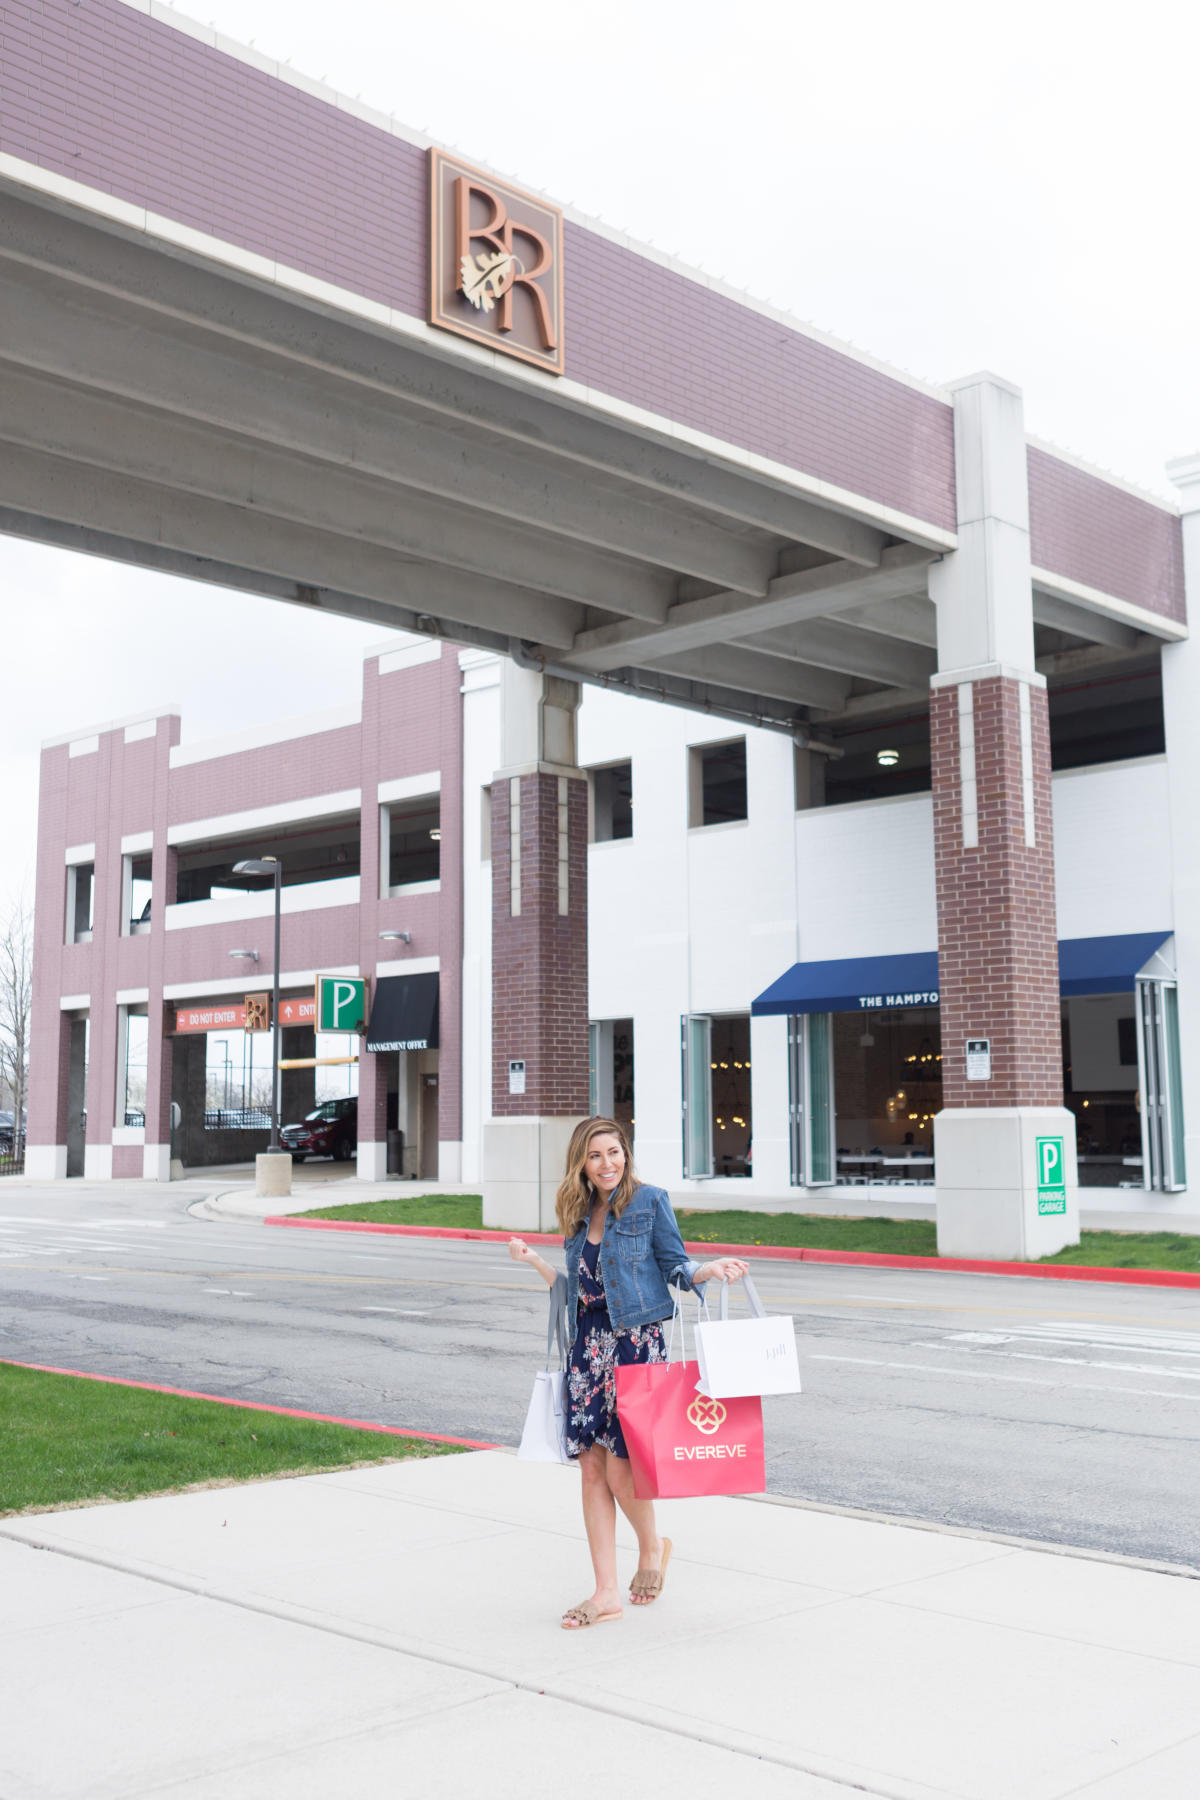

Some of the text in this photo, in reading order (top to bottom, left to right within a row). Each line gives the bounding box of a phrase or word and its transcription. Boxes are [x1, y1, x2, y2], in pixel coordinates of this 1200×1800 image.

[333, 982, 356, 1028] P
[859, 996, 882, 1008] THE
[189, 1010, 236, 1025] DO NOT ENTER
[367, 1039, 428, 1053] MANAGEMENT OFFICE
[1043, 1143, 1058, 1183] P
[674, 1444, 747, 1461] EVEREVE
